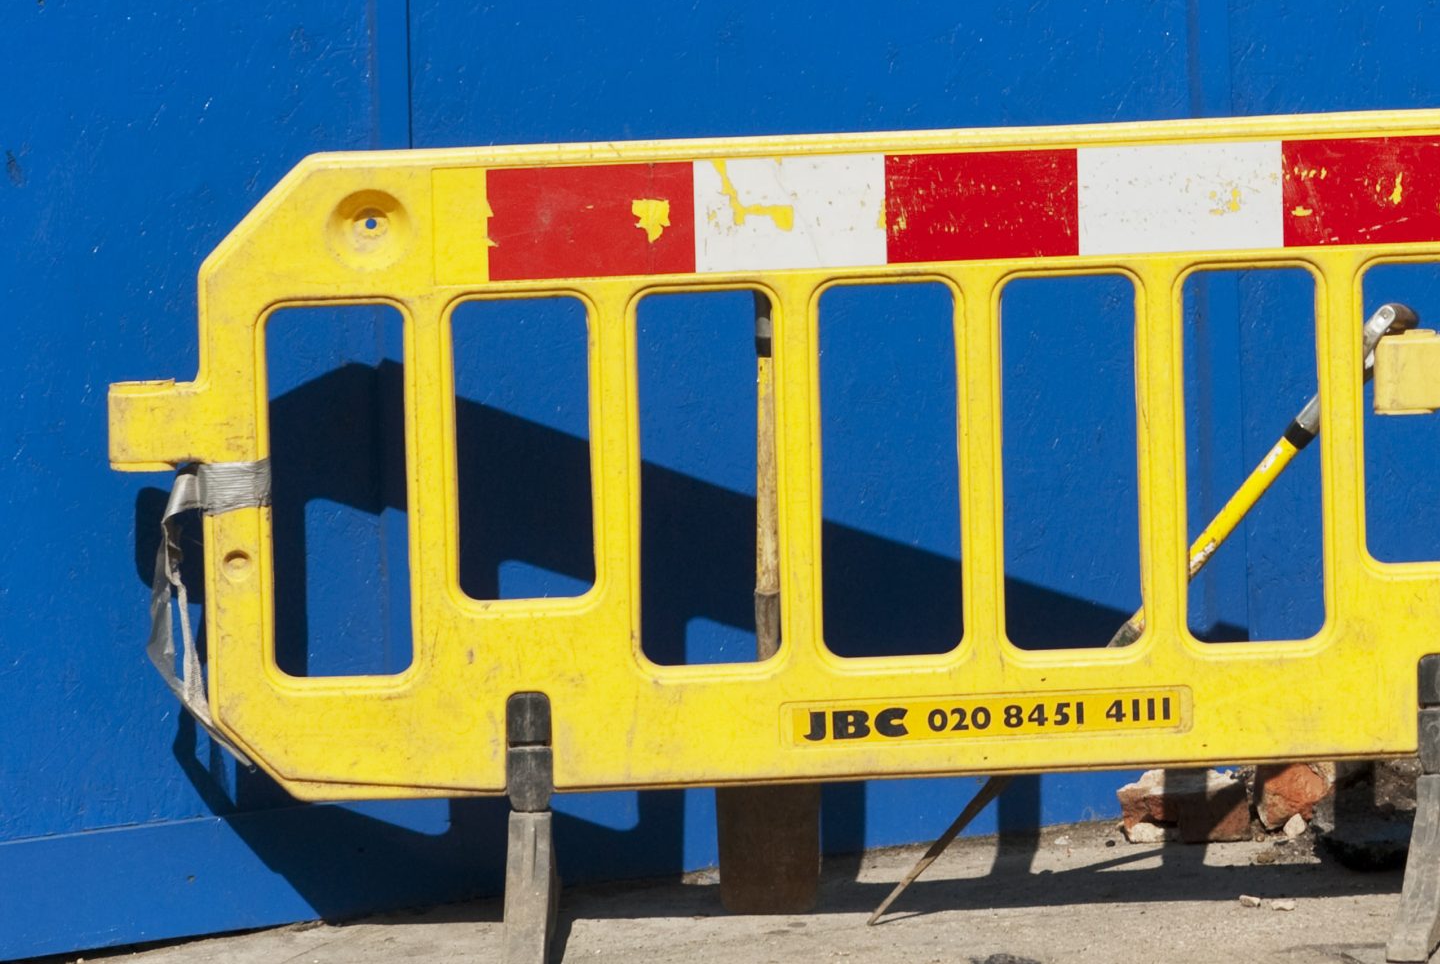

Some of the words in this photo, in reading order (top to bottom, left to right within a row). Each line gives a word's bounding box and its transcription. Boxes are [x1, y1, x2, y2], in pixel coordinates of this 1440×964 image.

[803, 707, 908, 741] JBC
[927, 707, 991, 732] 020
[1003, 701, 1085, 728] 8451
[1105, 697, 1171, 723] 4111
